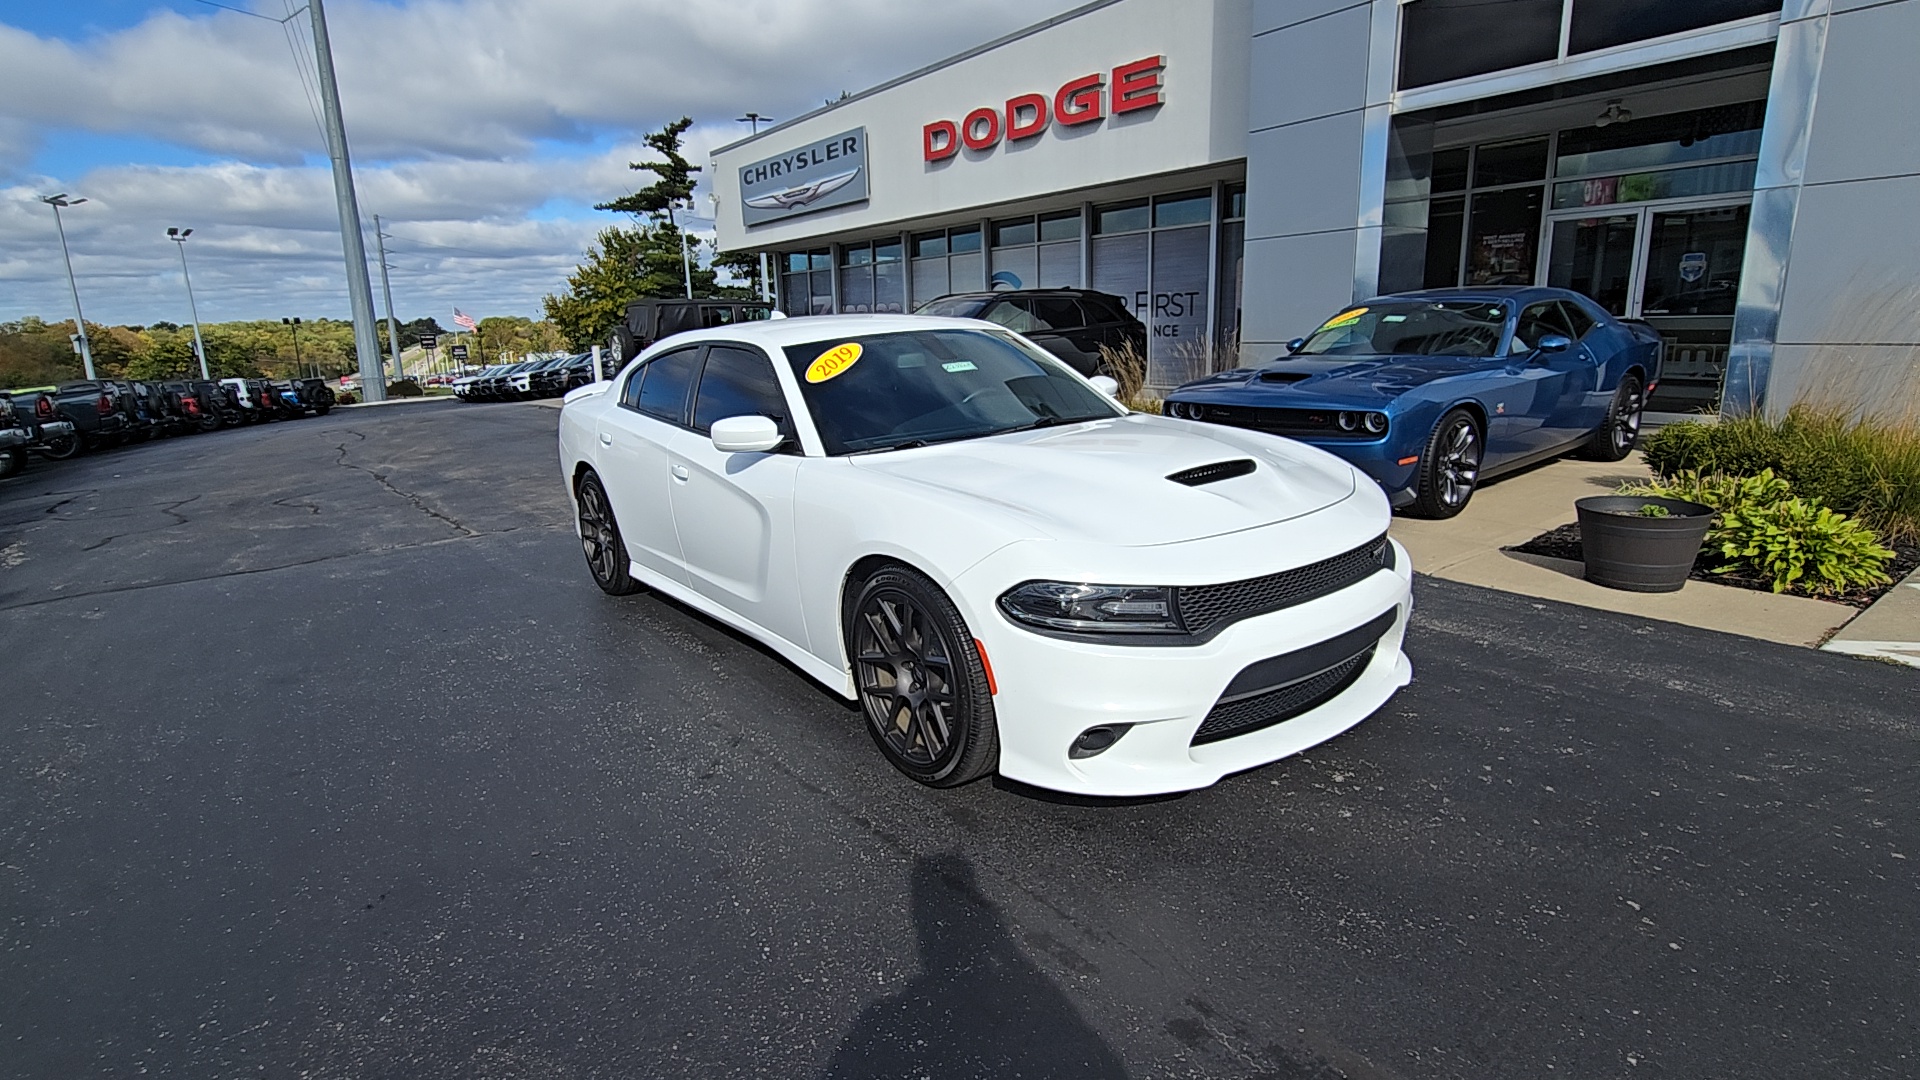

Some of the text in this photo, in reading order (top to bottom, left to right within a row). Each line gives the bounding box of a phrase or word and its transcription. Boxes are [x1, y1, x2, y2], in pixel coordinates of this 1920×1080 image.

[923, 55, 1164, 161] DODGE
[743, 136, 857, 185] CHRYSLER
[1135, 291, 1200, 318] FIRST
[815, 347, 853, 377] 2019
